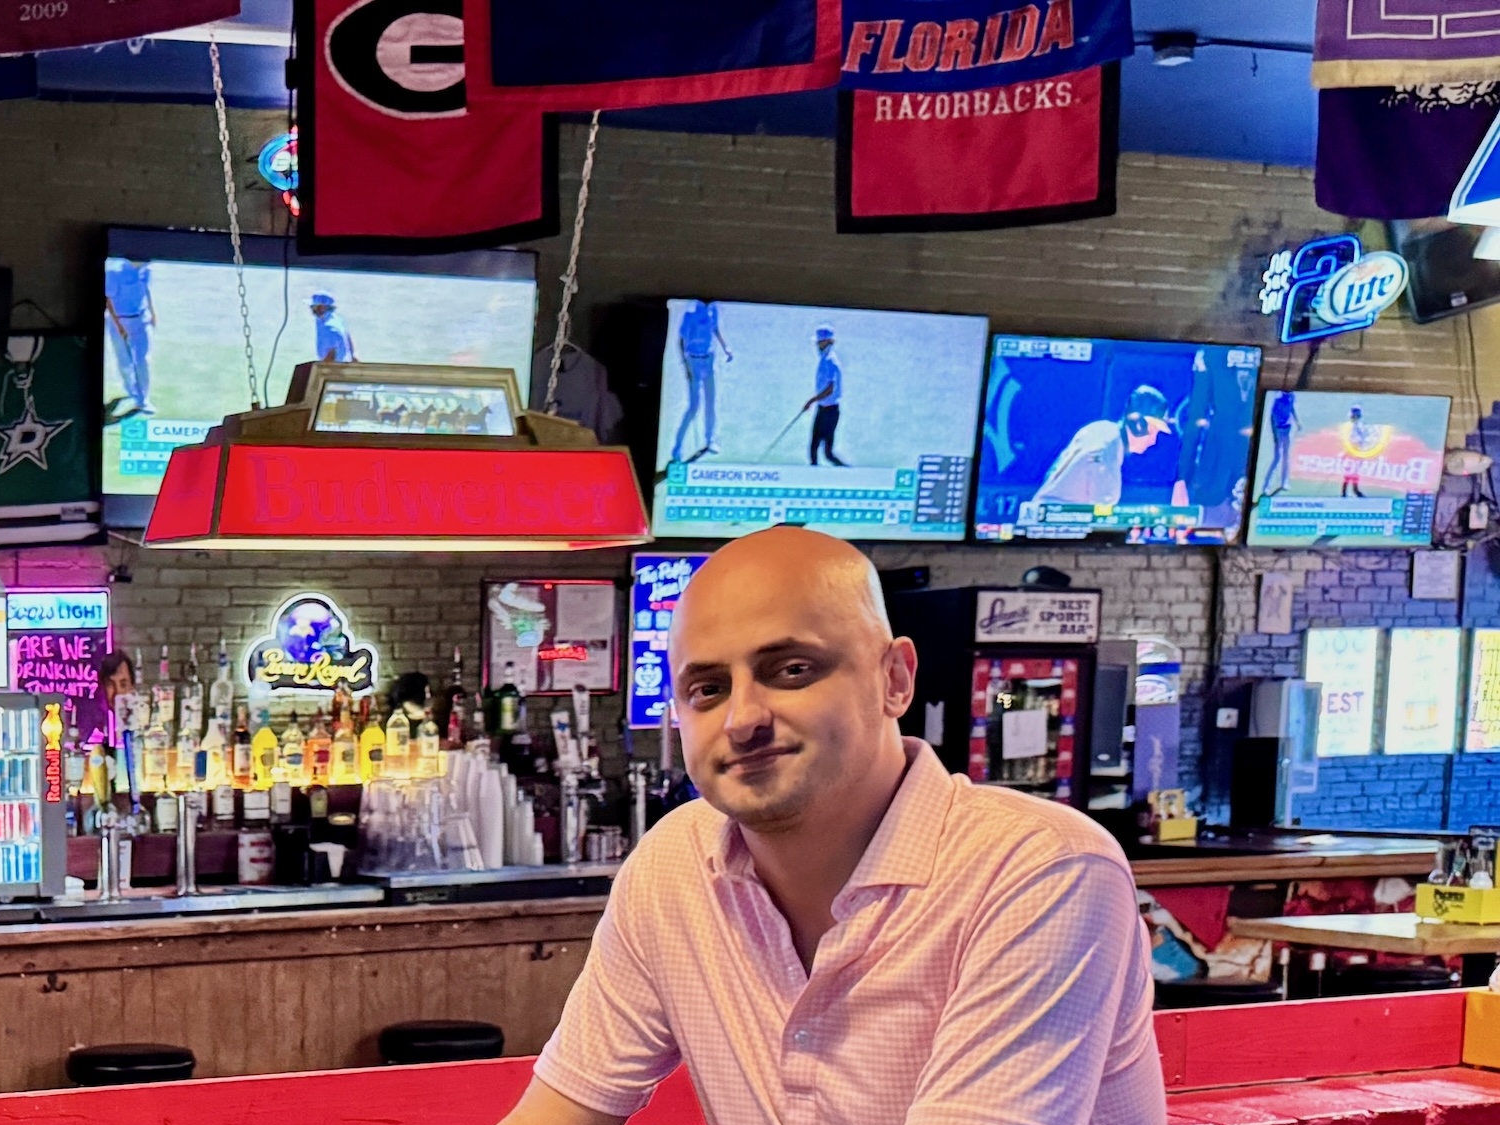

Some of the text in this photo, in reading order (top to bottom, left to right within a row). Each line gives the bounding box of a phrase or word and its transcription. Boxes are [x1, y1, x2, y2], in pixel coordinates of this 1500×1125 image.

[18, 1, 68, 21] 2009
[840, 0, 1075, 73] FLORIDA
[875, 81, 1073, 122] RAZORBACKS
[1344, 273, 1395, 315] Lite
[152, 426, 205, 437] CAMER
[249, 452, 621, 527] Budweiser
[58, 604, 102, 620] LIGHT
[18, 634, 92, 661] ARE WE
[293, 651, 367, 686] Royal
[46, 750, 60, 802] Red Bull
